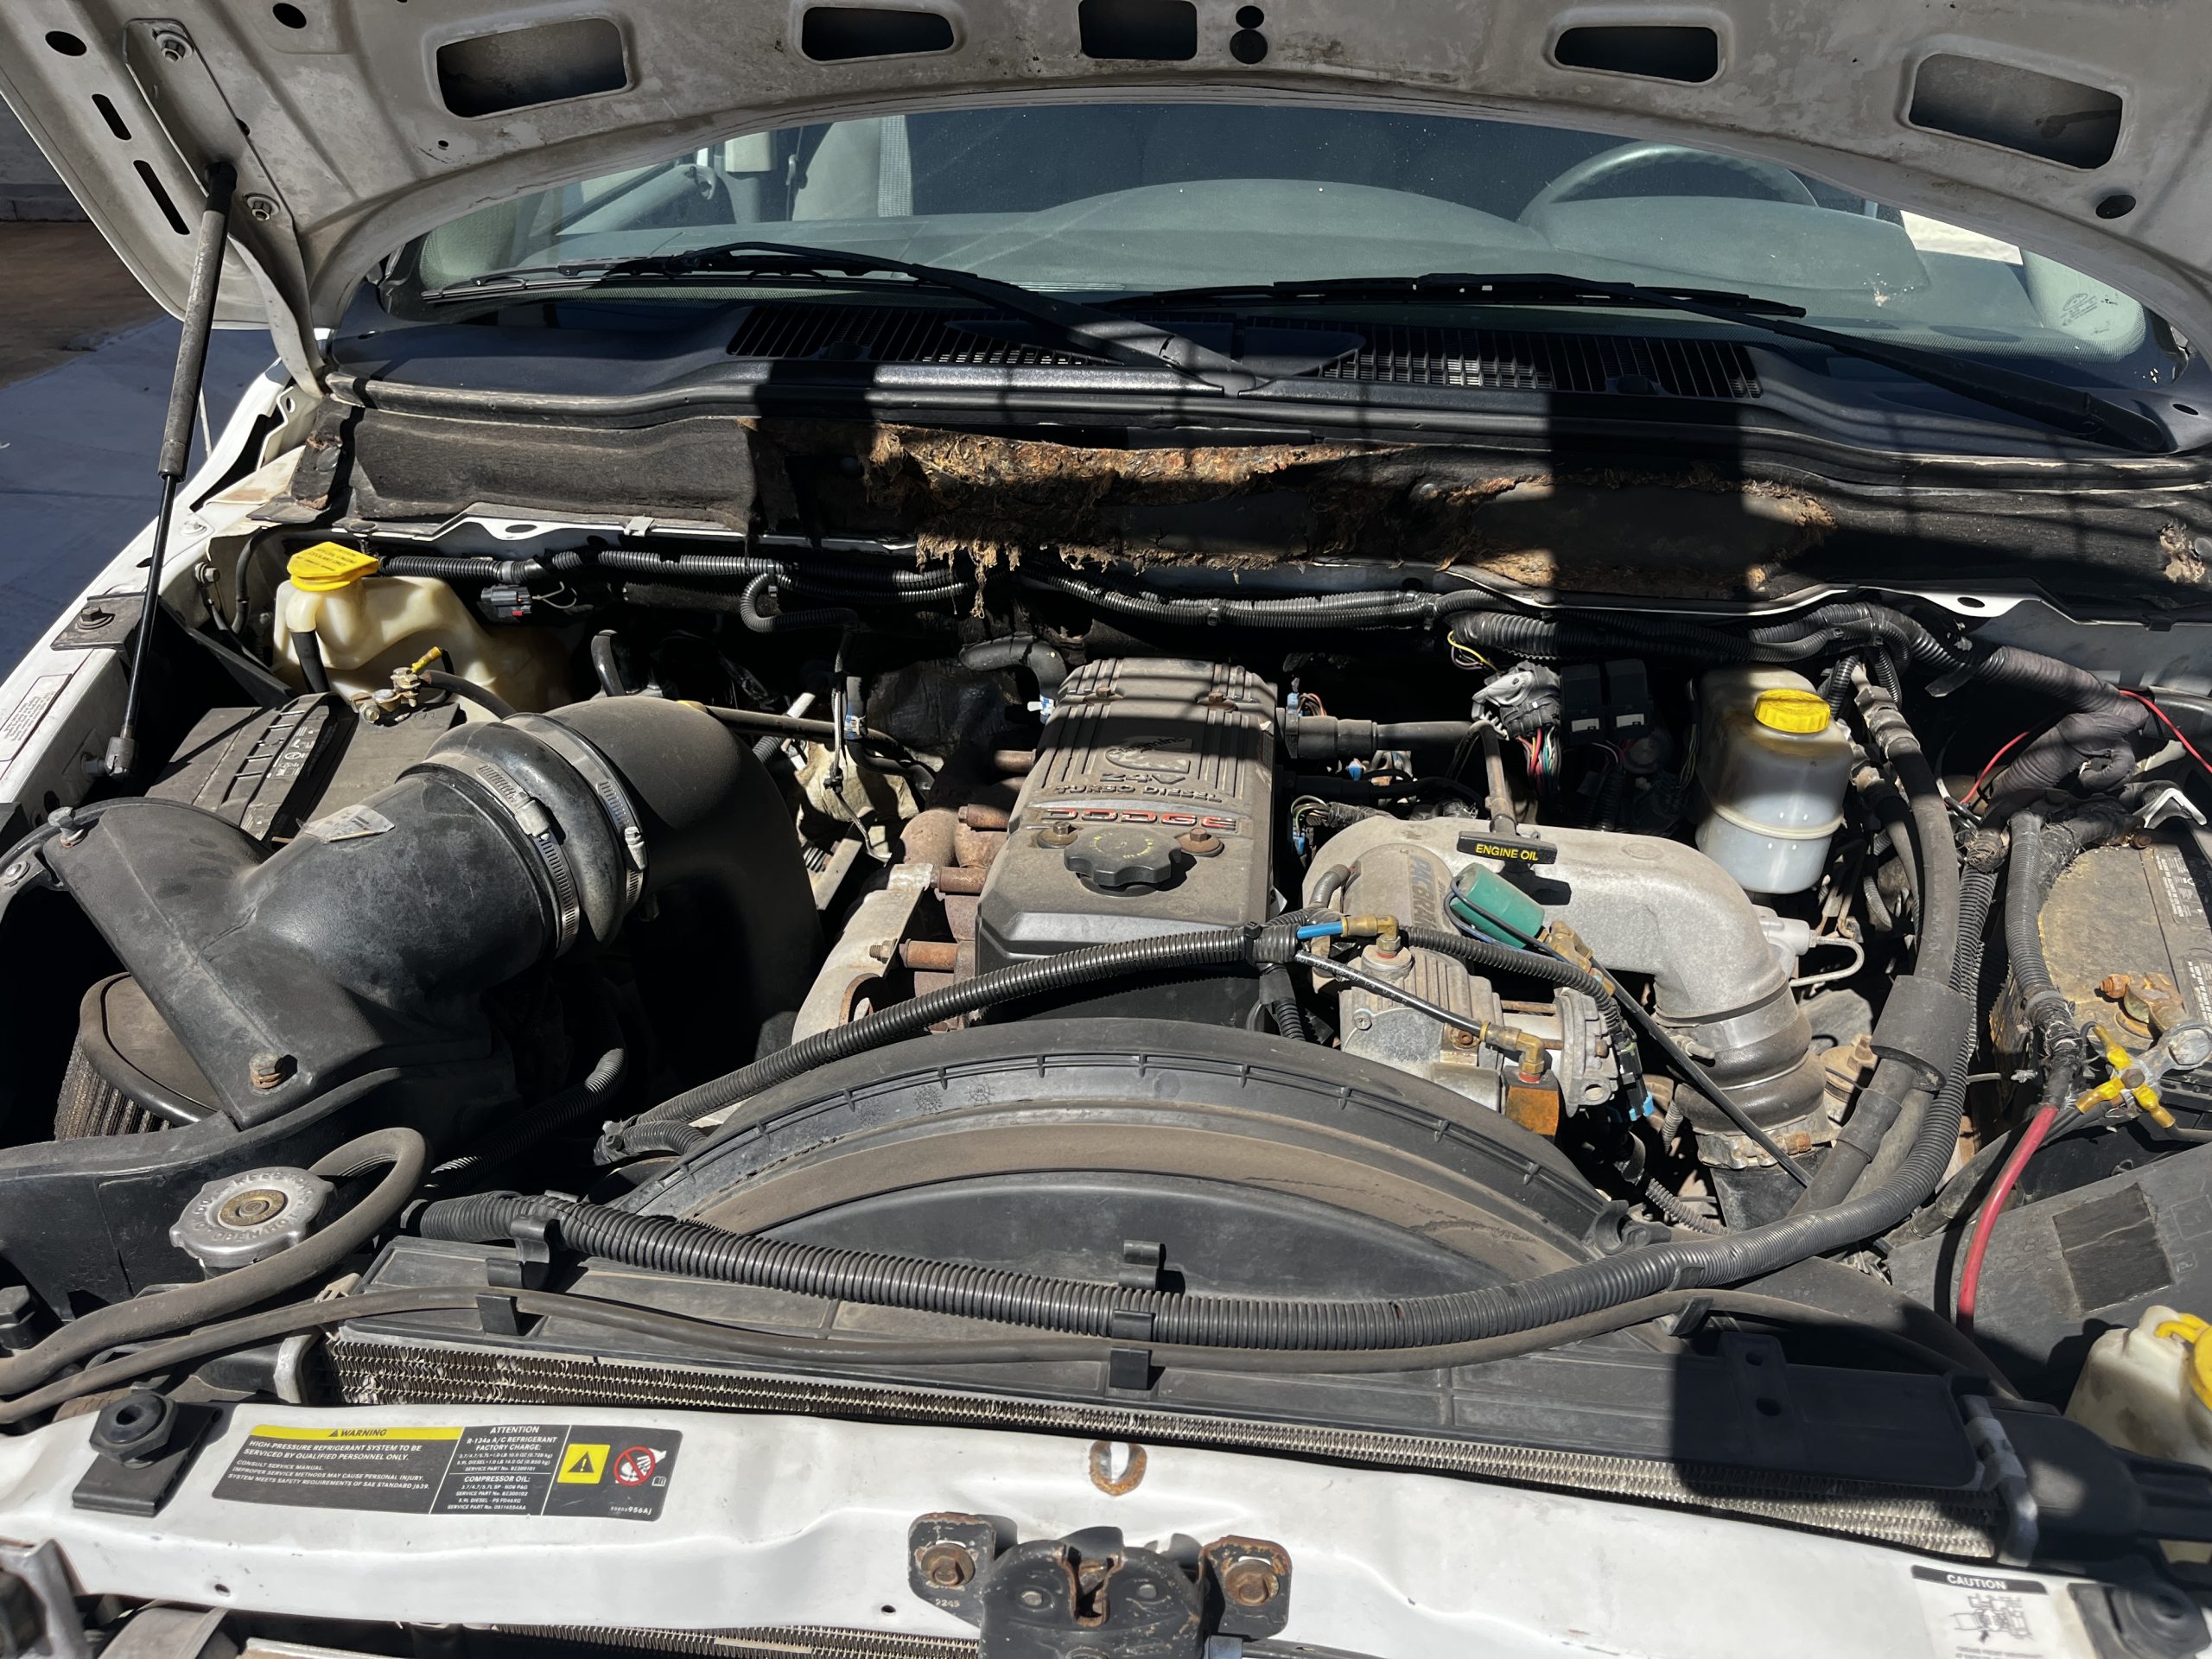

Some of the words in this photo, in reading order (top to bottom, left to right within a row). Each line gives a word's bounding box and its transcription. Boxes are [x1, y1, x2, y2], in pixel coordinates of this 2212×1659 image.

[1055, 784, 1135, 794] TURBO
[1143, 785, 1222, 803] DIESEL
[1041, 808, 1236, 830] DODGE
[1476, 843, 1518, 858] ENGINE
[1521, 849, 1538, 861] OIL
[490, 1426, 540, 1434] ATTENTION
[249, 1440, 312, 1451] HIGH-PRESSURE
[244, 1448, 283, 1458] SERVICED
[232, 1466, 267, 1475] IMPROPER
[1947, 1573, 2007, 1591] CAUTION
